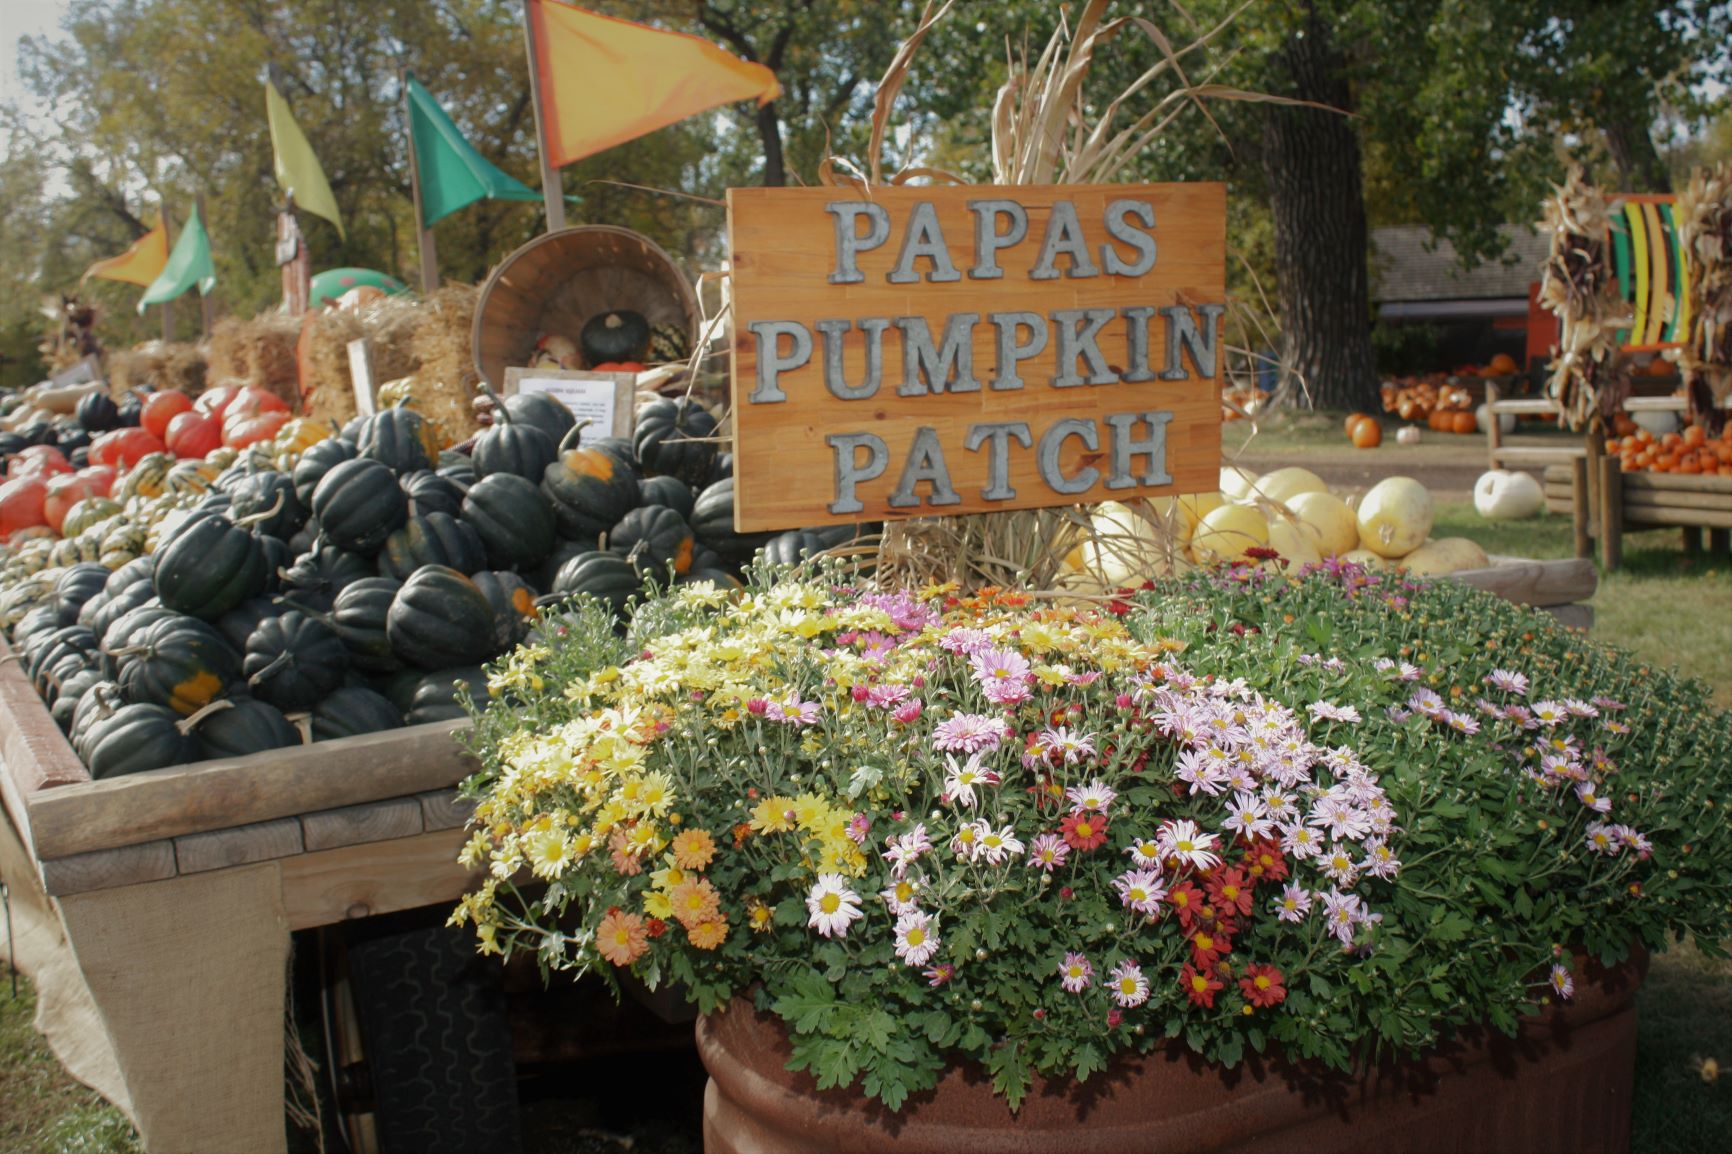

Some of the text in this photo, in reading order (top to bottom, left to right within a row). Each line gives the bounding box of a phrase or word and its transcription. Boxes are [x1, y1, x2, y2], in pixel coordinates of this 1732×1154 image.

[826, 200, 1157, 284] PAPAS
[748, 304, 1225, 404] PUMPKIN
[826, 411, 1174, 514] PATCH
